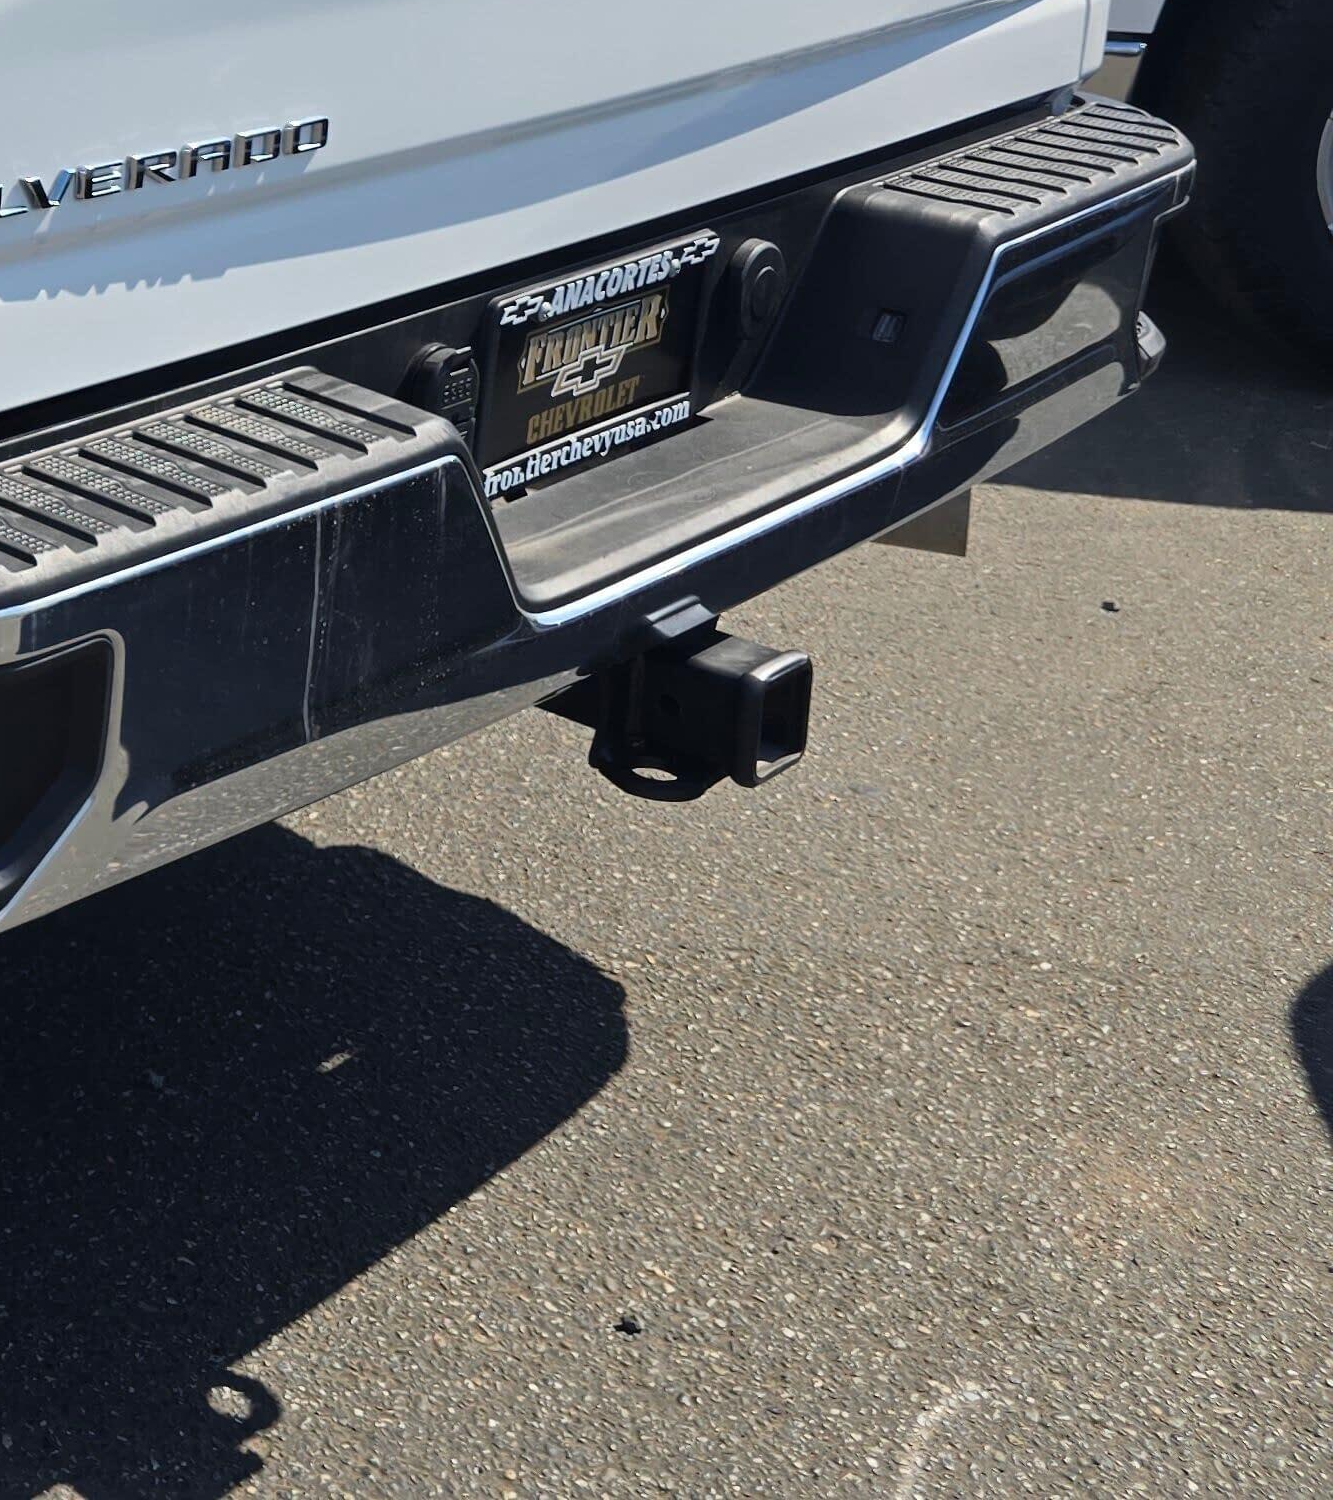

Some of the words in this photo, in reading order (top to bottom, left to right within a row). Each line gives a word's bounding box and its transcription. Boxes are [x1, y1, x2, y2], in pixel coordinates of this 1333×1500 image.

[549, 250, 674, 316] ANACORTES
[521, 294, 663, 386] FRONTIER
[526, 376, 641, 445] CHEVROLET
